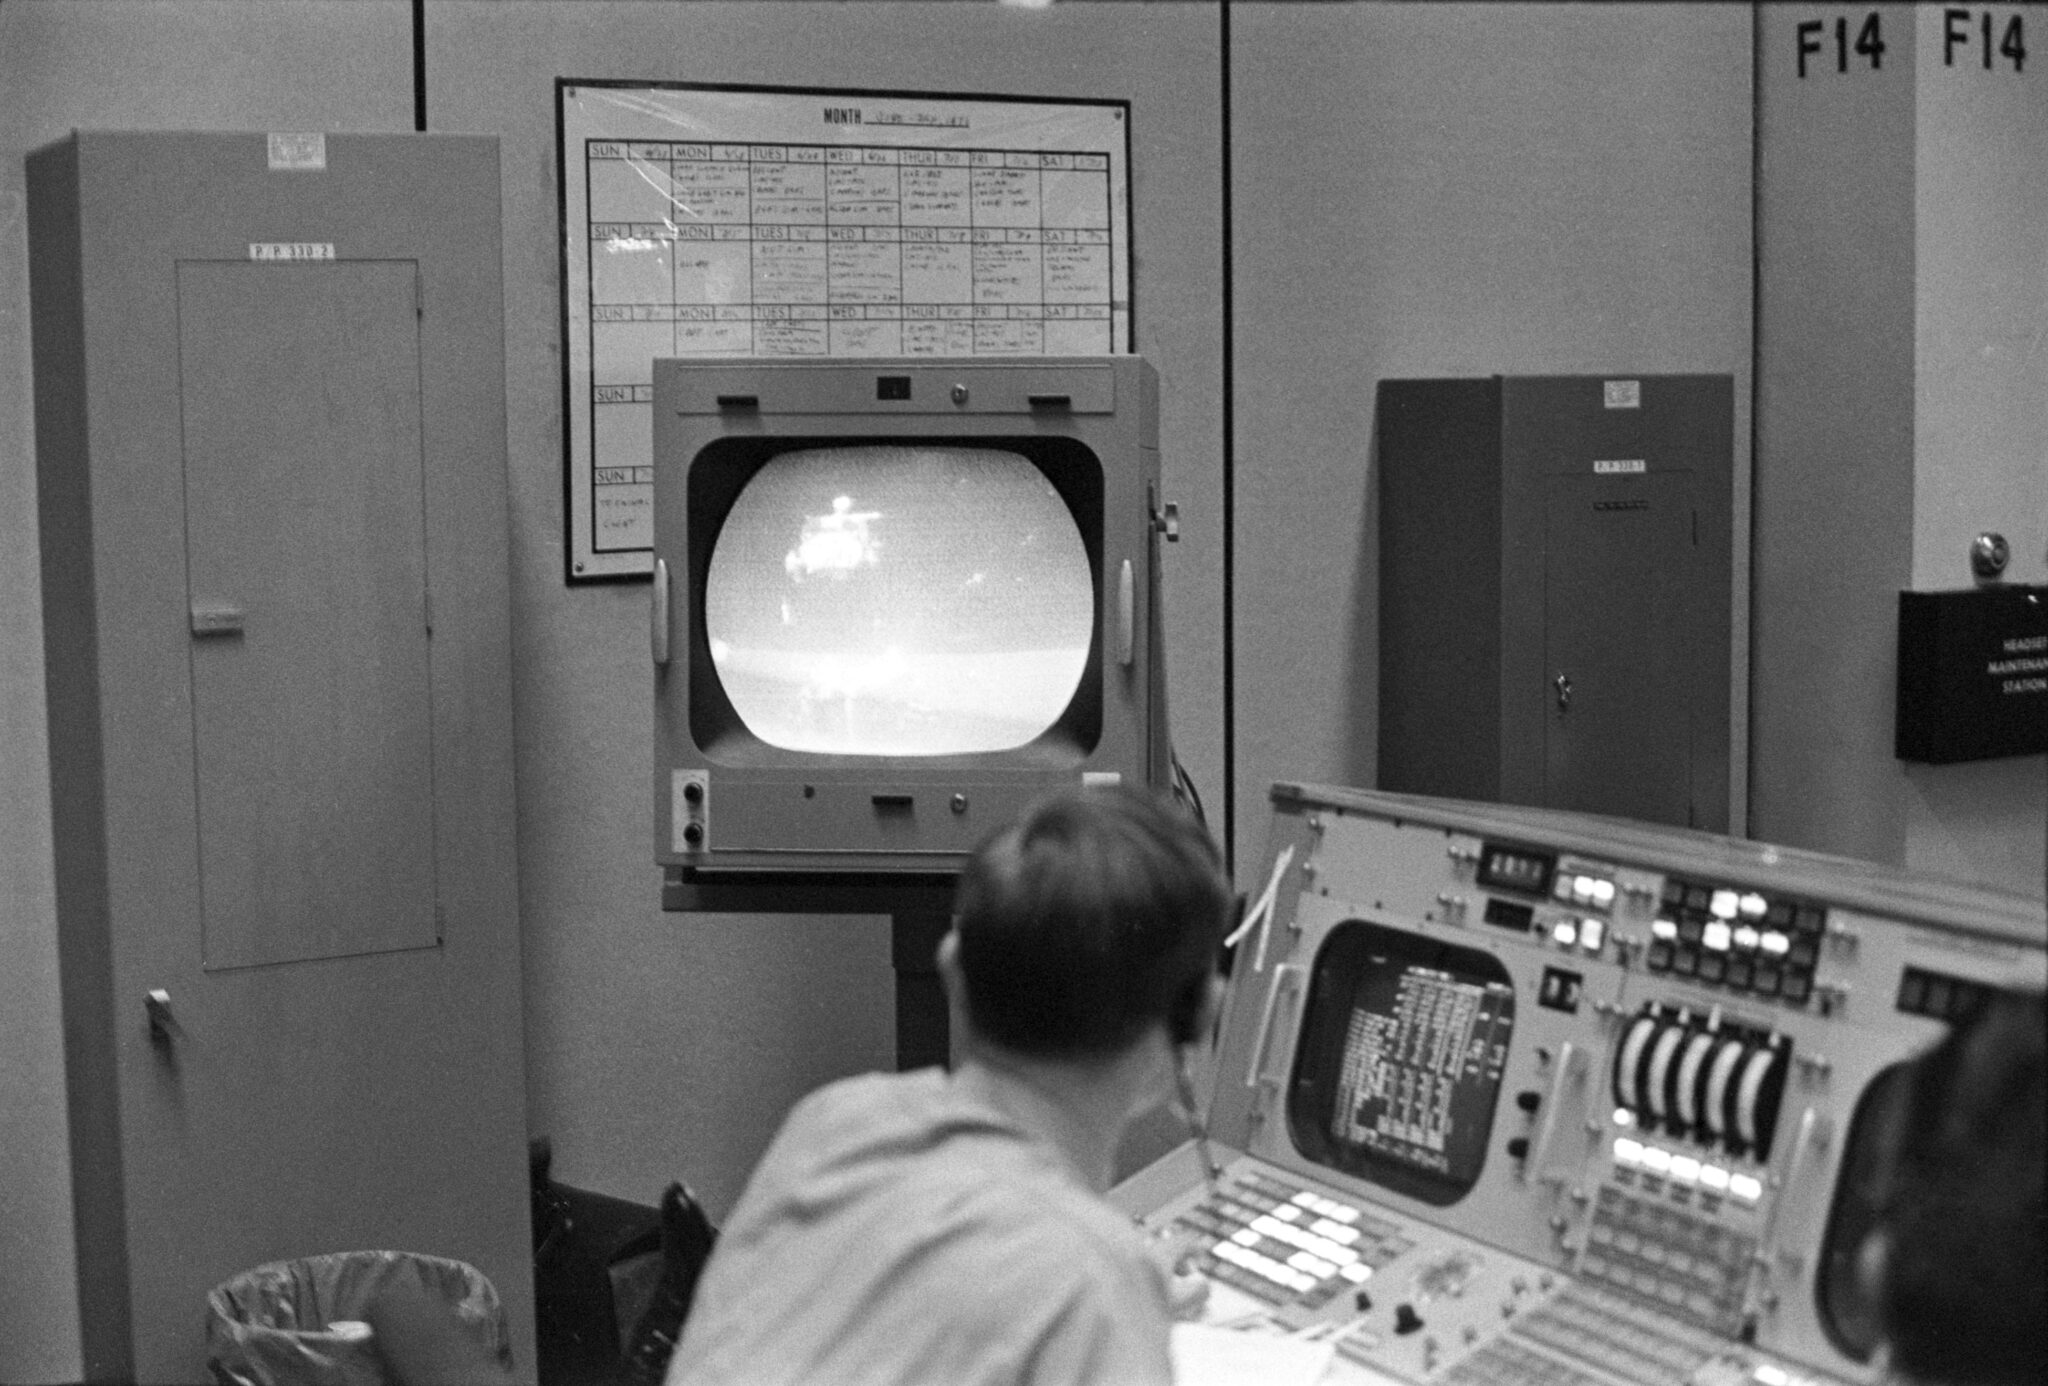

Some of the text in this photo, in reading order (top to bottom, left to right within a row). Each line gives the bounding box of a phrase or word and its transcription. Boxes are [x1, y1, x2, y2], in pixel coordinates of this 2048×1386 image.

[1797, 11, 1885, 79] F14
[1944, 8, 2025, 72] F14
[824, 108, 862, 124] MONTH
[593, 145, 619, 156] SUN
[676, 147, 707, 158] MON
[753, 148, 782, 159] TUES
[830, 150, 853, 161] WED
[903, 151, 933, 163] THUR
[971, 153, 988, 163] FRI
[1042, 155, 1064, 166] SAT
[594, 226, 622, 237] SUN
[678, 226, 709, 238] MON
[754, 226, 783, 238] TUES
[831, 227, 855, 239] WED
[904, 229, 935, 240] THUR
[973, 230, 990, 241] FRI
[1044, 231, 1066, 242] SAT
[596, 307, 623, 319] SUN
[679, 307, 710, 319] MON
[756, 307, 785, 318] TUES
[832, 308, 856, 318] WED
[905, 307, 935, 318] THUR
[973, 307, 991, 318] FRI
[1044, 307, 1067, 318] SAT
[597, 389, 625, 401] SUN
[597, 470, 625, 482] SUN
[2002, 678, 2047, 694] STATION
